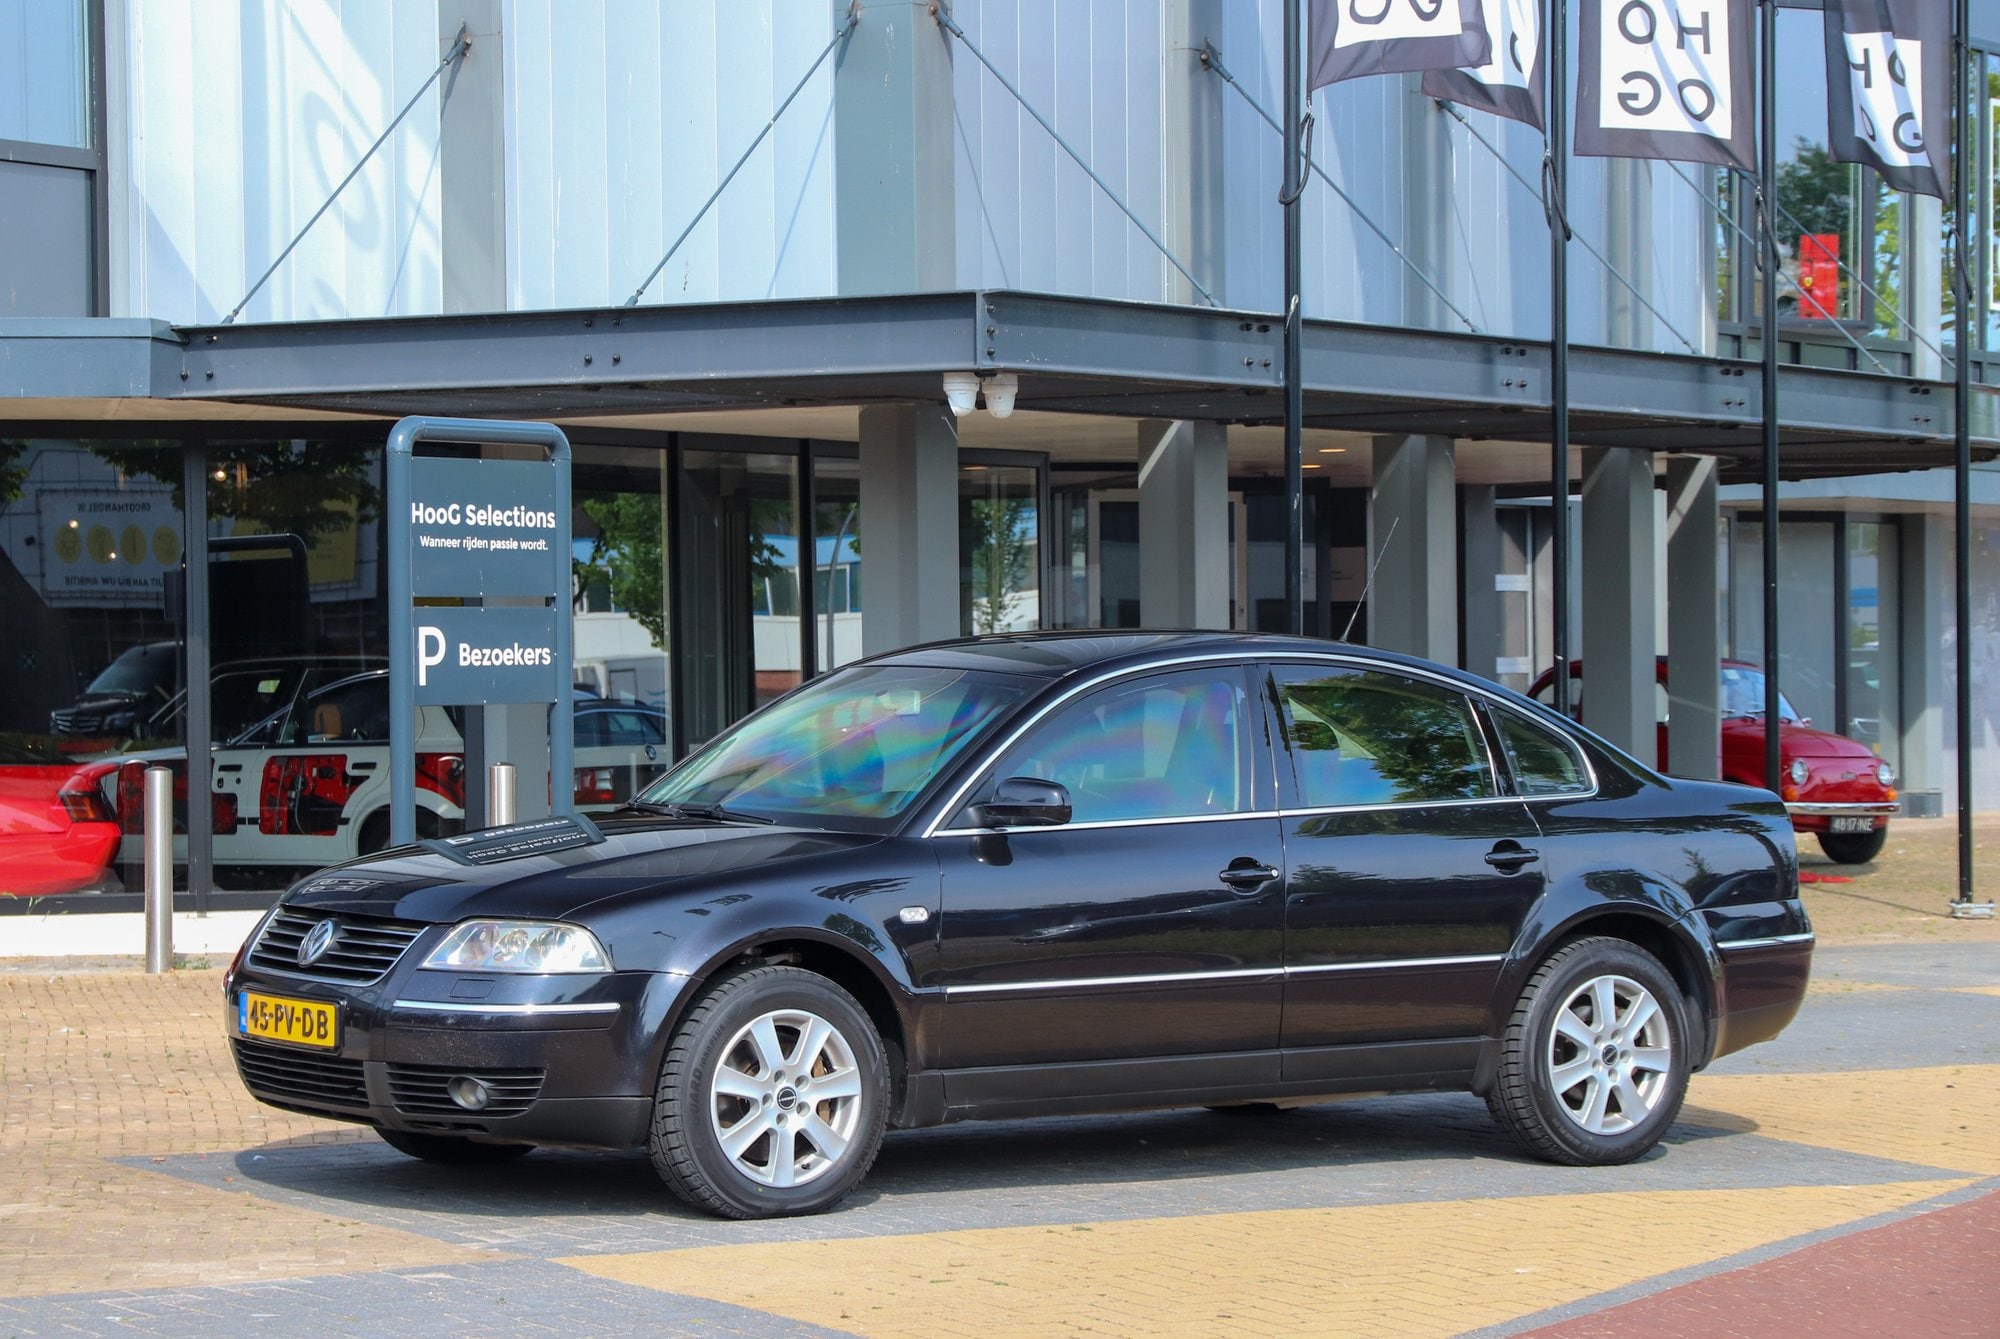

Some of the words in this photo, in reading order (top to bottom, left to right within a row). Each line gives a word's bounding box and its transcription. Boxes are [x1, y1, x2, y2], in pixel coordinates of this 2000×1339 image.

[411, 502, 461, 525] HooG
[465, 504, 556, 529] Selections
[419, 535, 461, 548] Wanneer
[463, 536, 488, 551] rijden
[490, 538, 518, 551] passie
[520, 539, 548, 551] wordt.
[418, 626, 446, 687] P
[459, 642, 551, 667] Bezoekers
[249, 999, 329, 1040] 45-PV-DB
